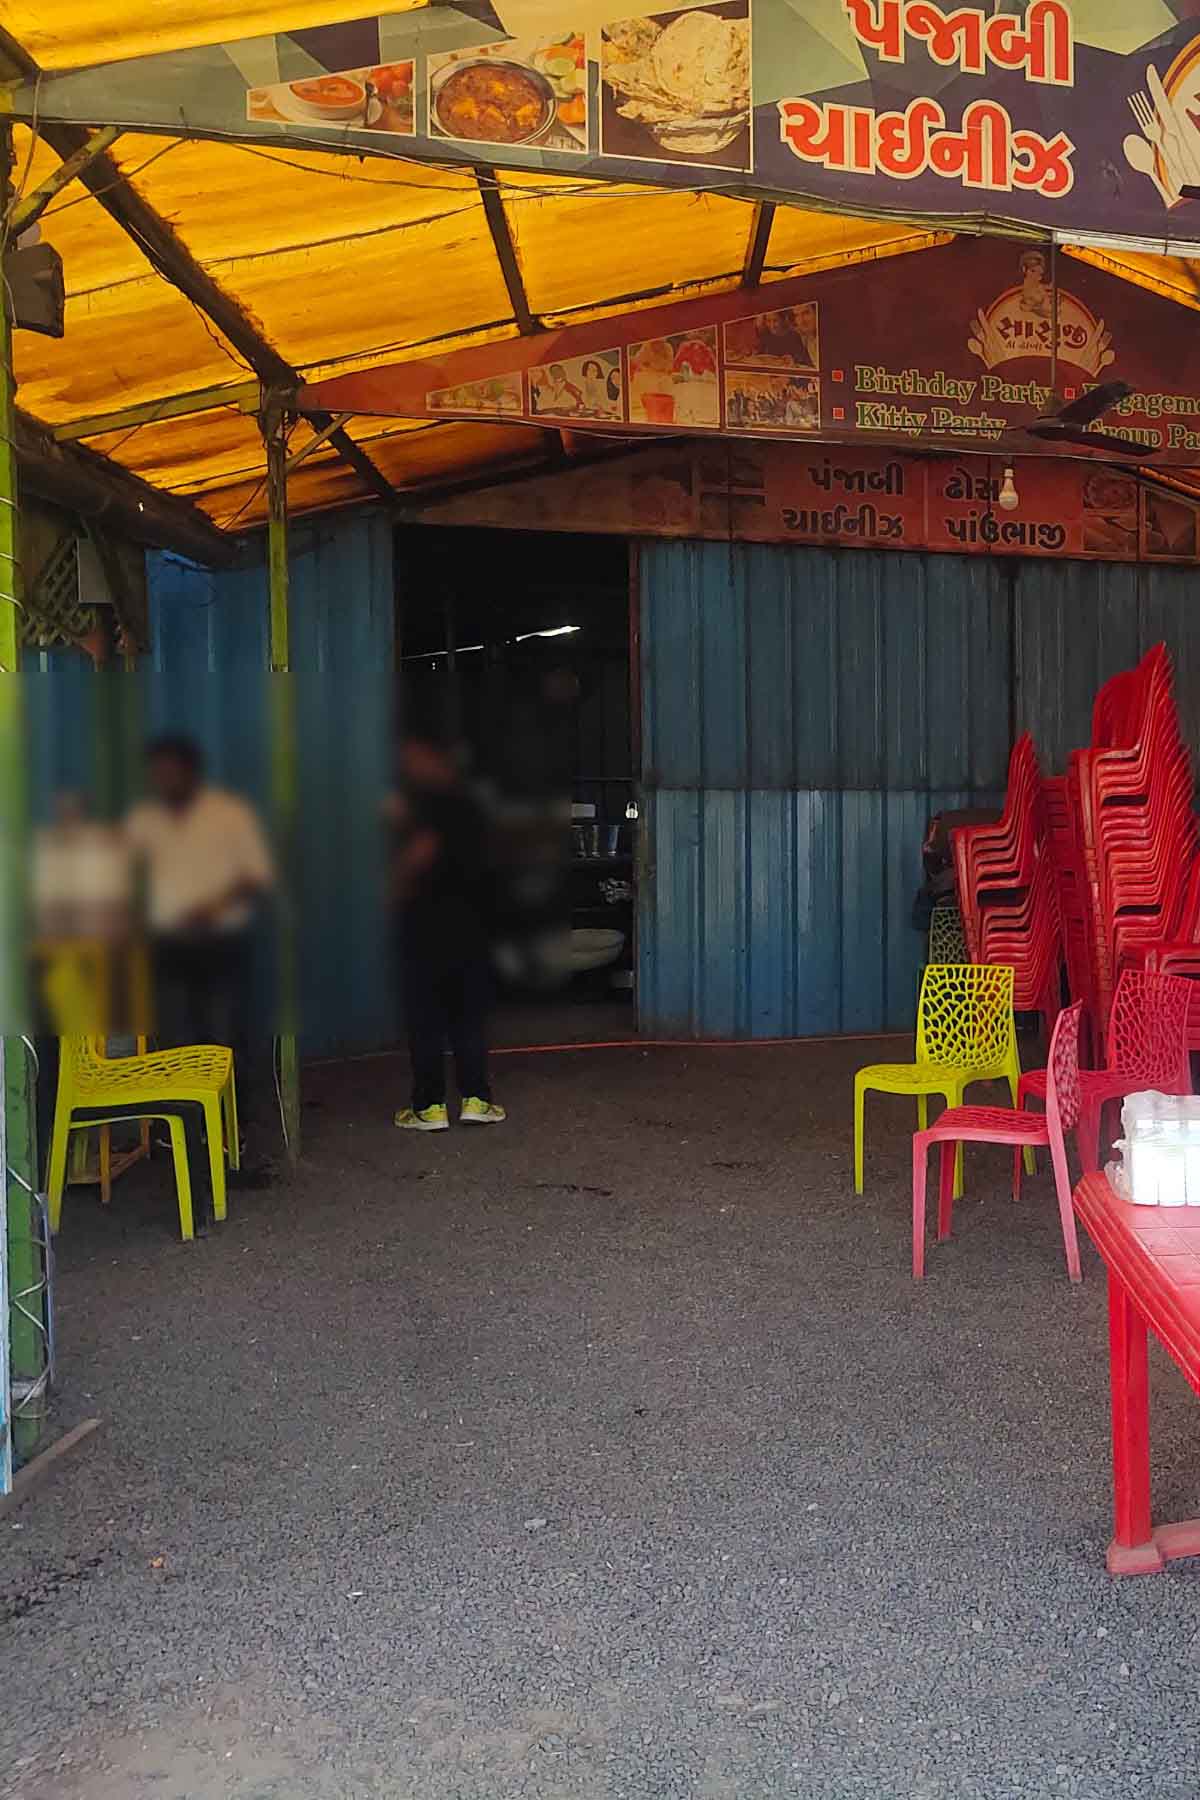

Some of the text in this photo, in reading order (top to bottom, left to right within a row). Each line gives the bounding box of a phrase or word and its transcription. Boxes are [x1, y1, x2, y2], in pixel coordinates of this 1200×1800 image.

[777, 97, 1076, 198] ચાઈનીઝ
[855, 365, 1054, 411] Birthday Party
[855, 401, 1007, 440] Kitty Party
[808, 458, 904, 496] પંજાબી
[944, 464, 1001, 501] ઢોસ
[781, 504, 904, 539] ચાઈનીઝ
